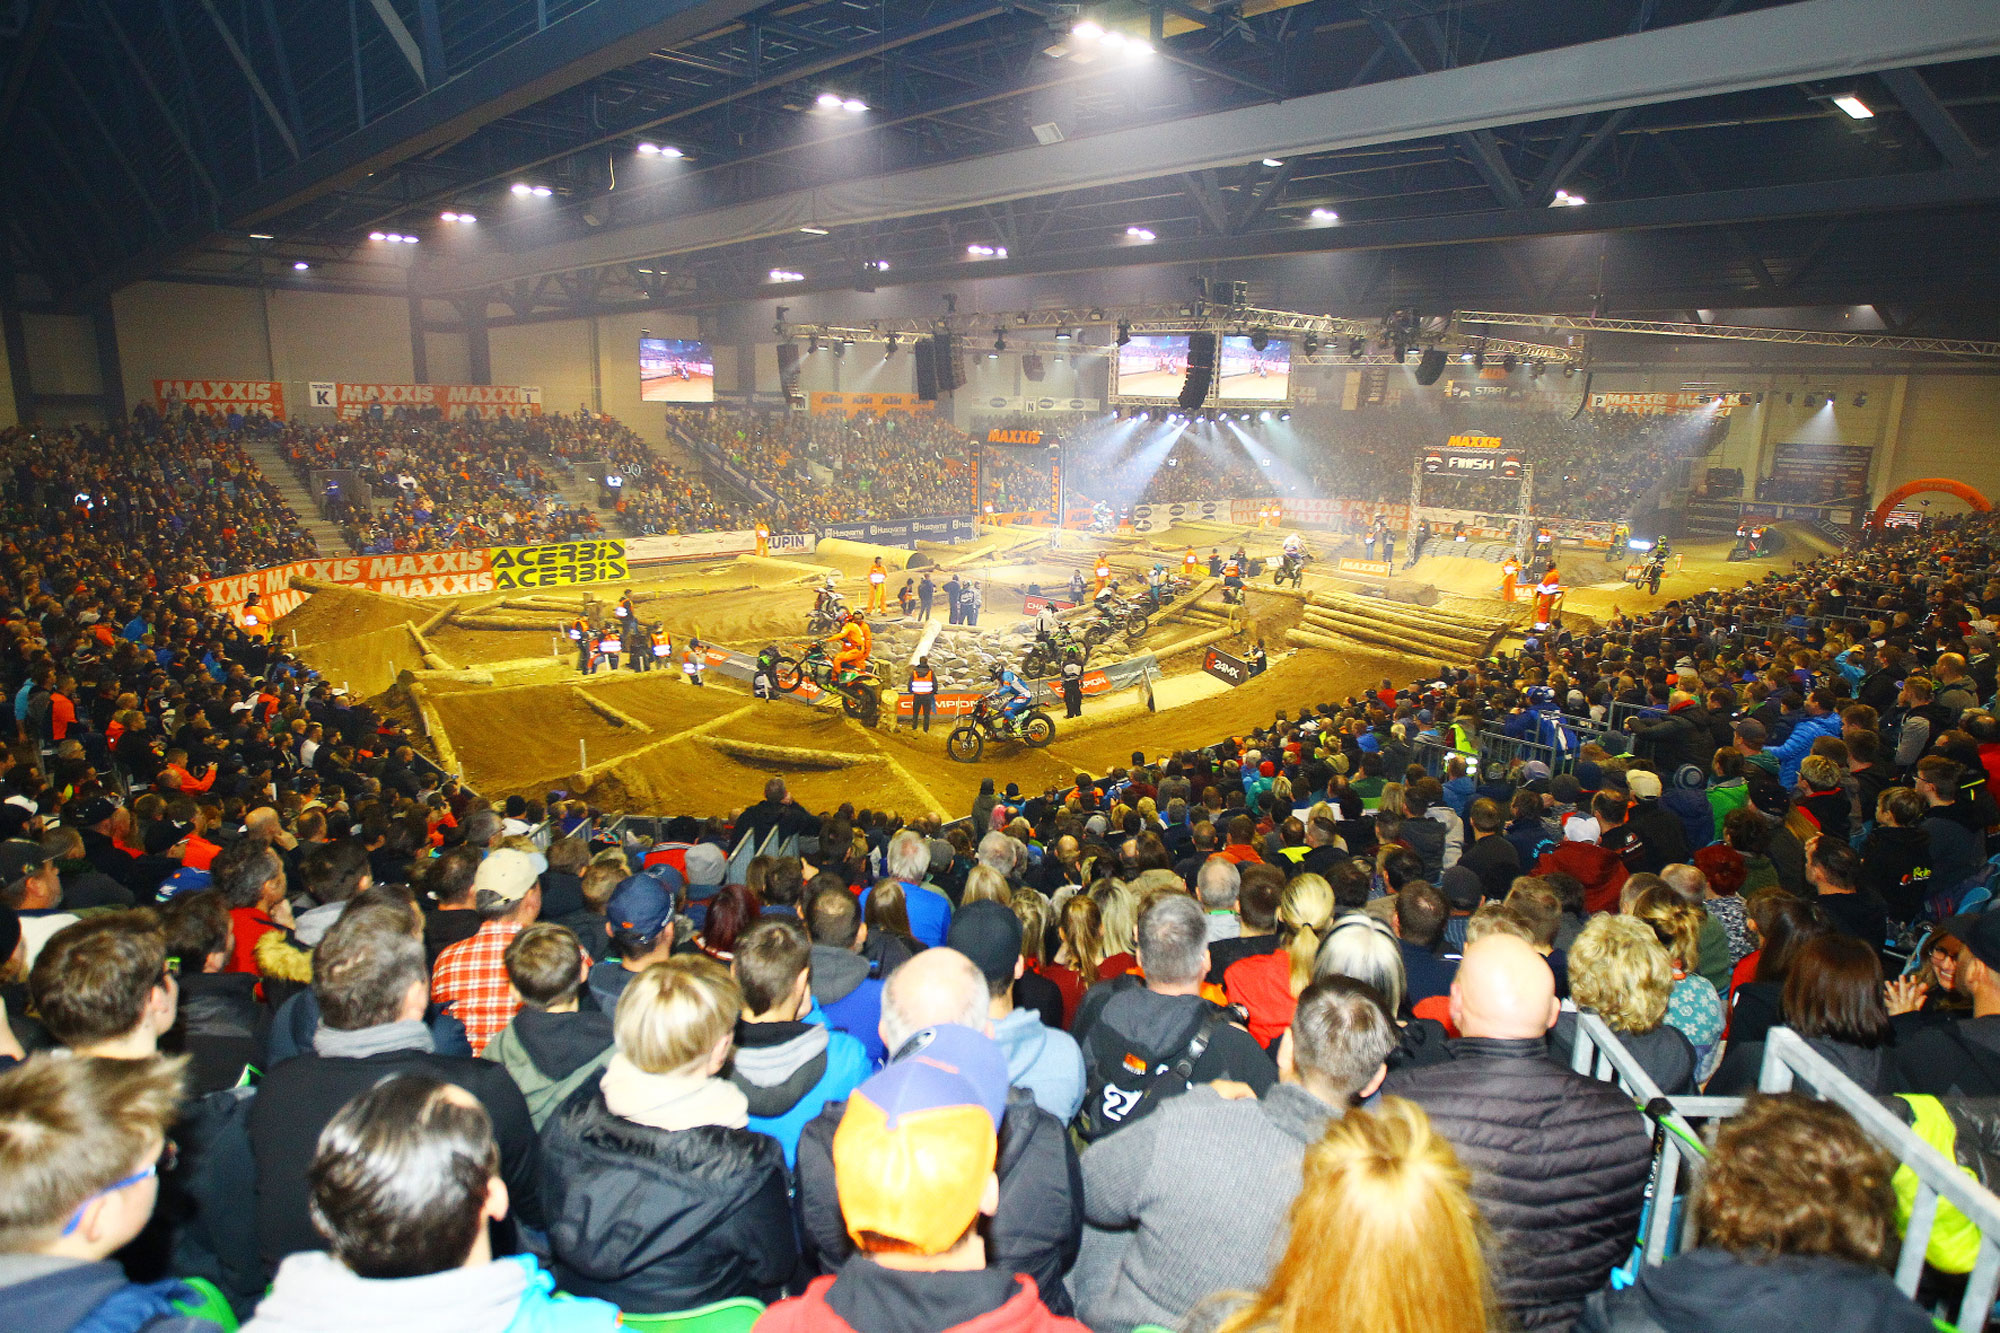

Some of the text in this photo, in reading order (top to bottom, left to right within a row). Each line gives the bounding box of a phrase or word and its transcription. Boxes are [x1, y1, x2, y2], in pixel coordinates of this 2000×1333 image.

[160, 381, 271, 400] MAXXIS
[317, 391, 329, 405] K
[341, 385, 434, 402] MAXXIS
[1475, 386, 1508, 396] START
[1596, 397, 1603, 405] P
[1606, 394, 1668, 405] MAXXIS
[987, 429, 1041, 444] MAXXIS
[1447, 435, 1502, 448] MAXXIS
[1448, 457, 1496, 470] FINISH
[1051, 465, 1060, 515] MAXXIS
[491, 541, 625, 568] ACERBIS
[368, 550, 484, 580] MAXXIS
[1342, 561, 1385, 573] MAXXIS
[497, 561, 626, 590] ACERBIS
[381, 571, 494, 598] MAXXIS
